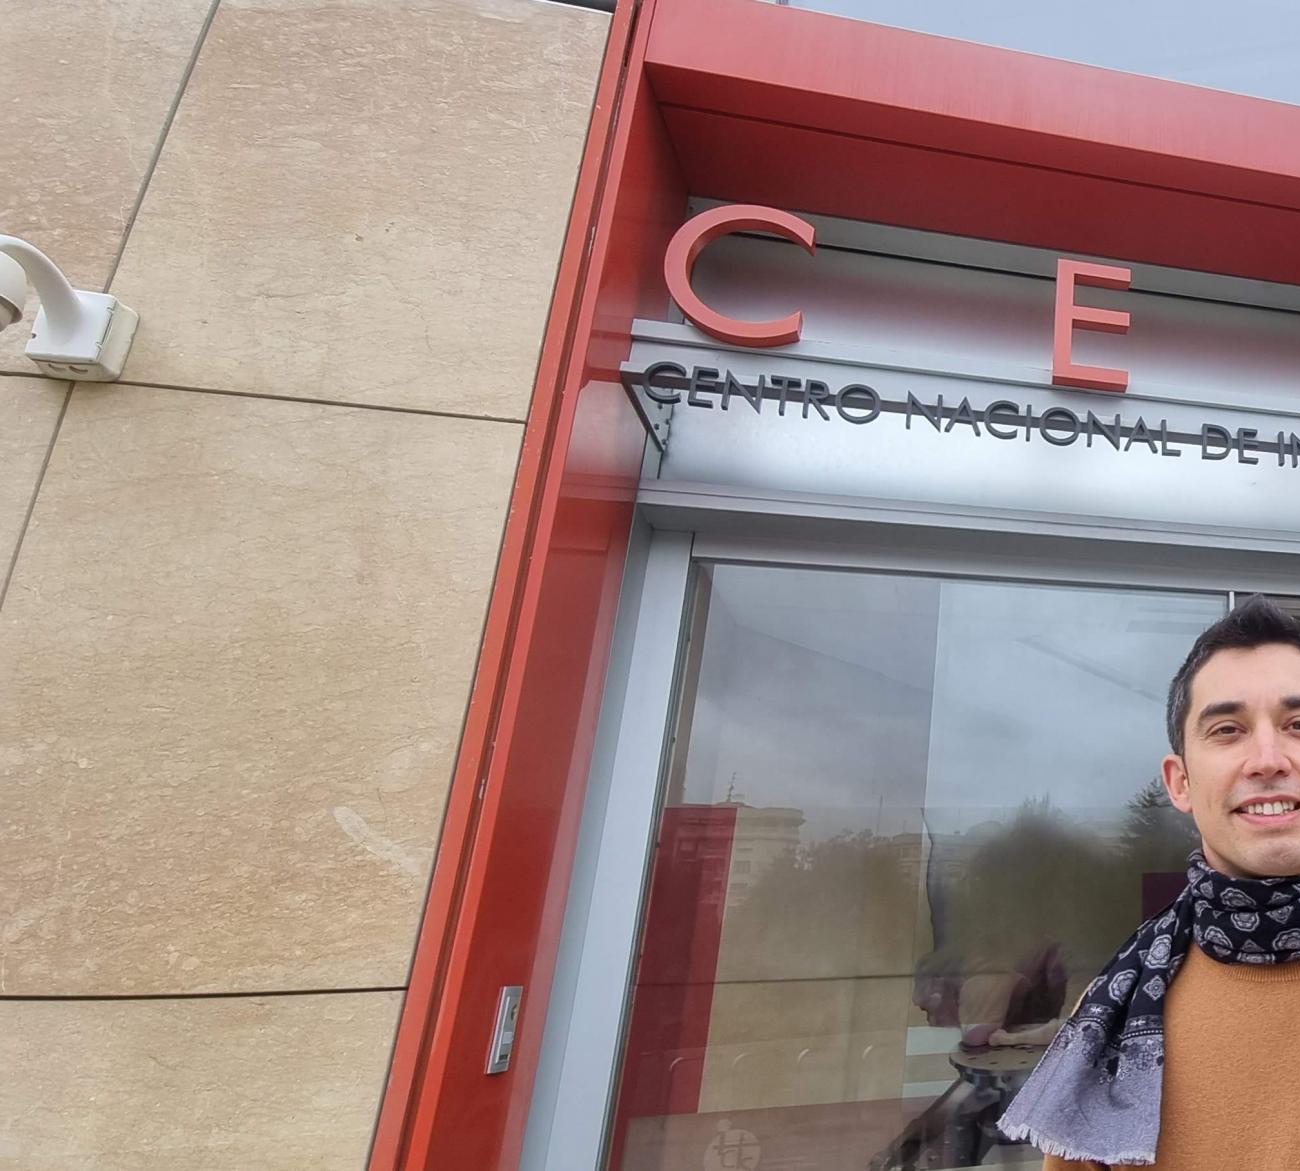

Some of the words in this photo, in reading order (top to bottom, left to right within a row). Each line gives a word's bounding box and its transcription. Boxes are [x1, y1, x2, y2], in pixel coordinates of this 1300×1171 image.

[643, 361, 881, 425] CENTRO
[906, 391, 1181, 456] NACIONAL
[1201, 423, 1259, 465] DE
